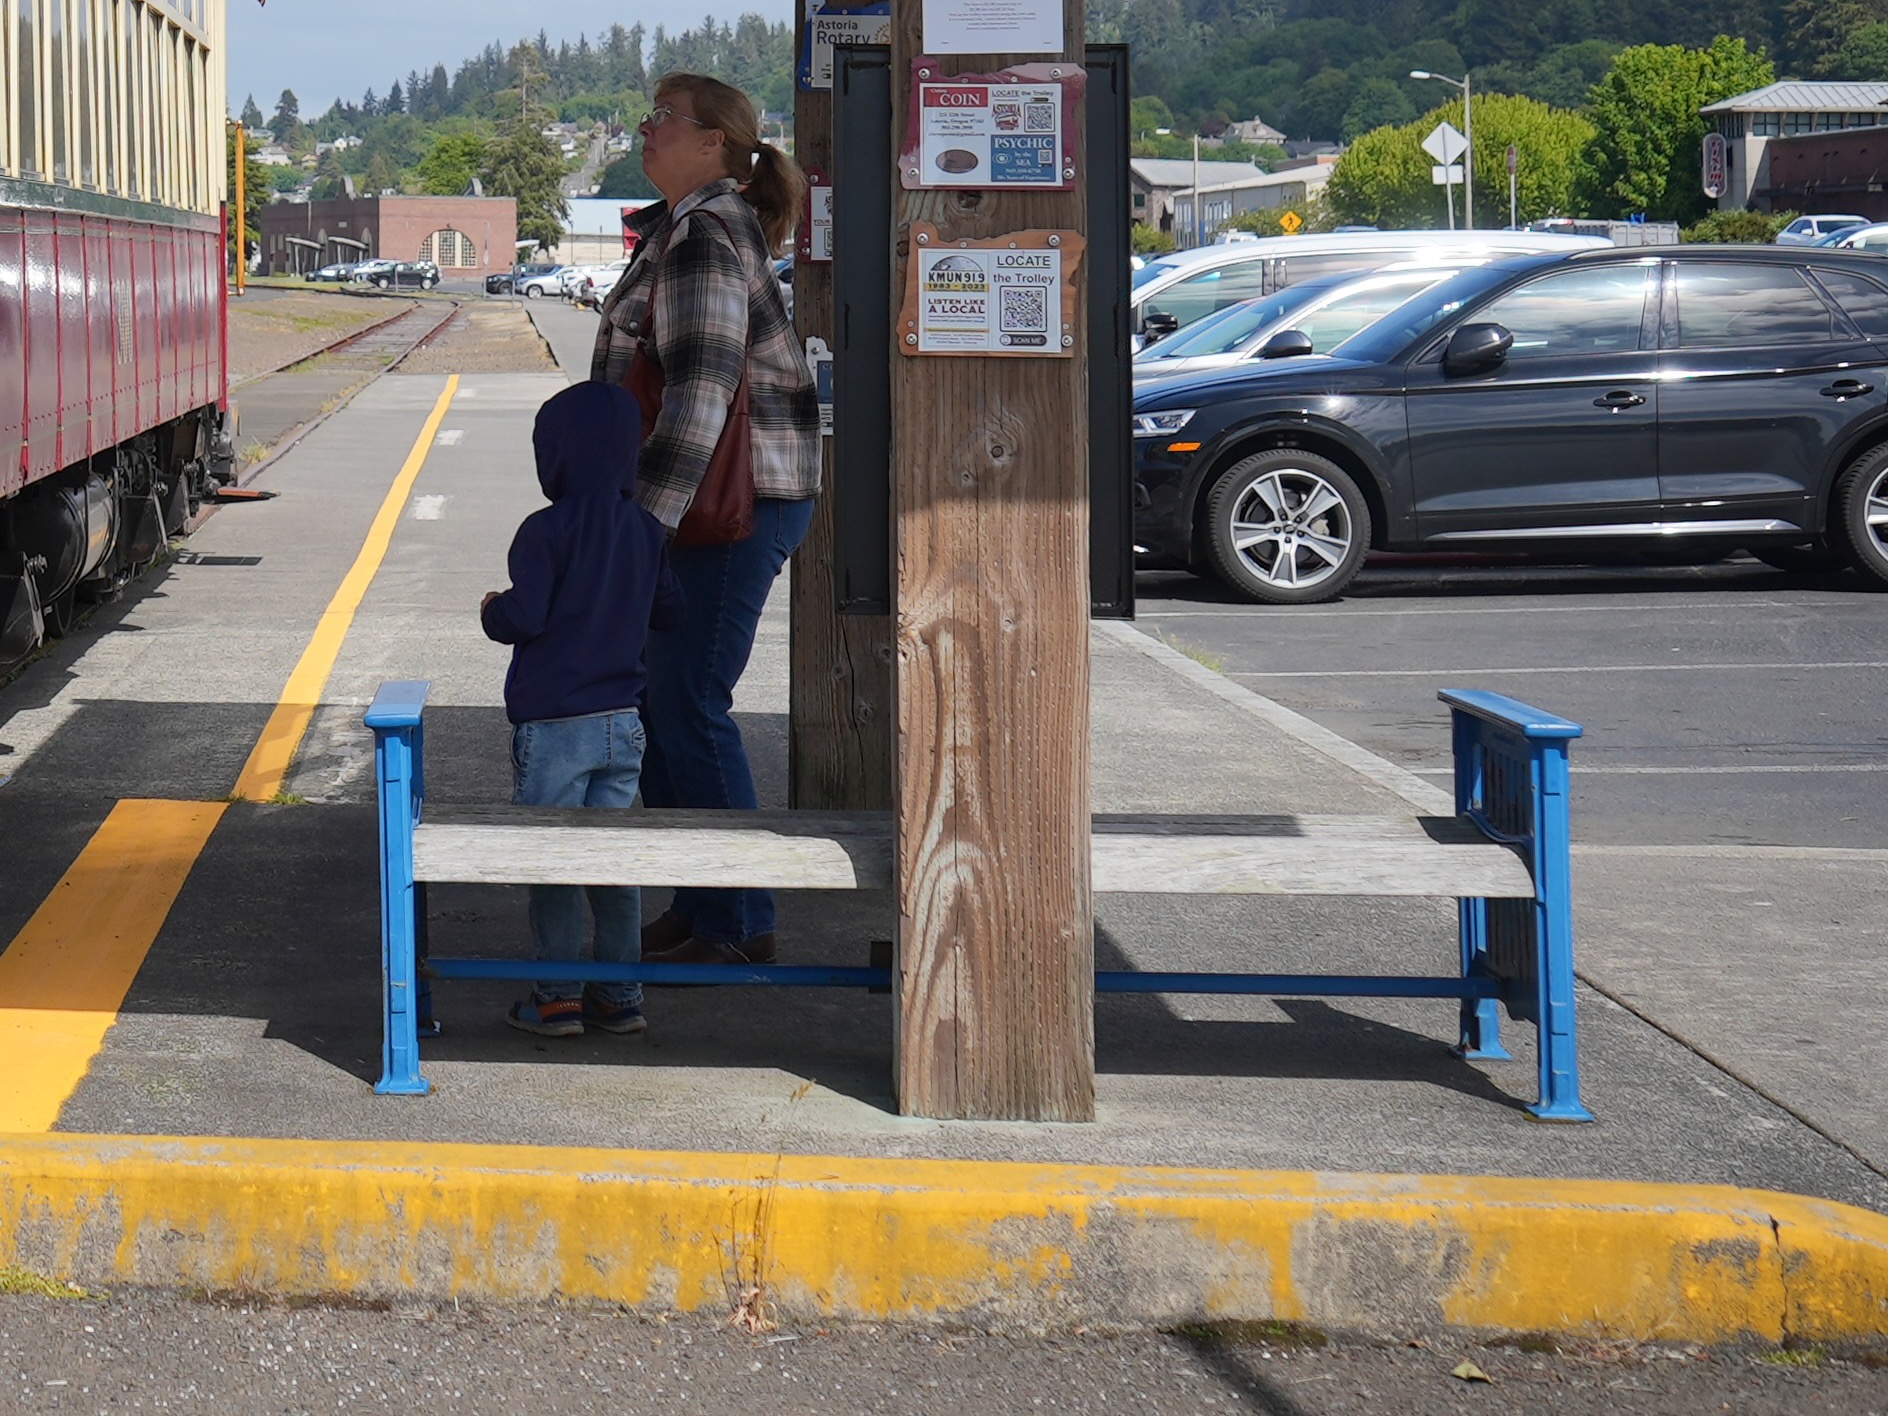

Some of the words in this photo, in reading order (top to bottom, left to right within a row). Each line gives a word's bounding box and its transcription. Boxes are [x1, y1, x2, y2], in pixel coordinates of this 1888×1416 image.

[817, 20, 858, 30] Astoria
[817, 31, 870, 45] Rotary
[940, 93, 981, 106] COIN
[994, 137, 1053, 149] PSYCHIC
[997, 255, 1051, 266] LOCATE
[928, 272, 962, 283] KMUN
[993, 274, 1011, 283] the
[1015, 273, 1055, 286] Trolley
[928, 305, 938, 314] A
[942, 305, 986, 314] LOCAL
